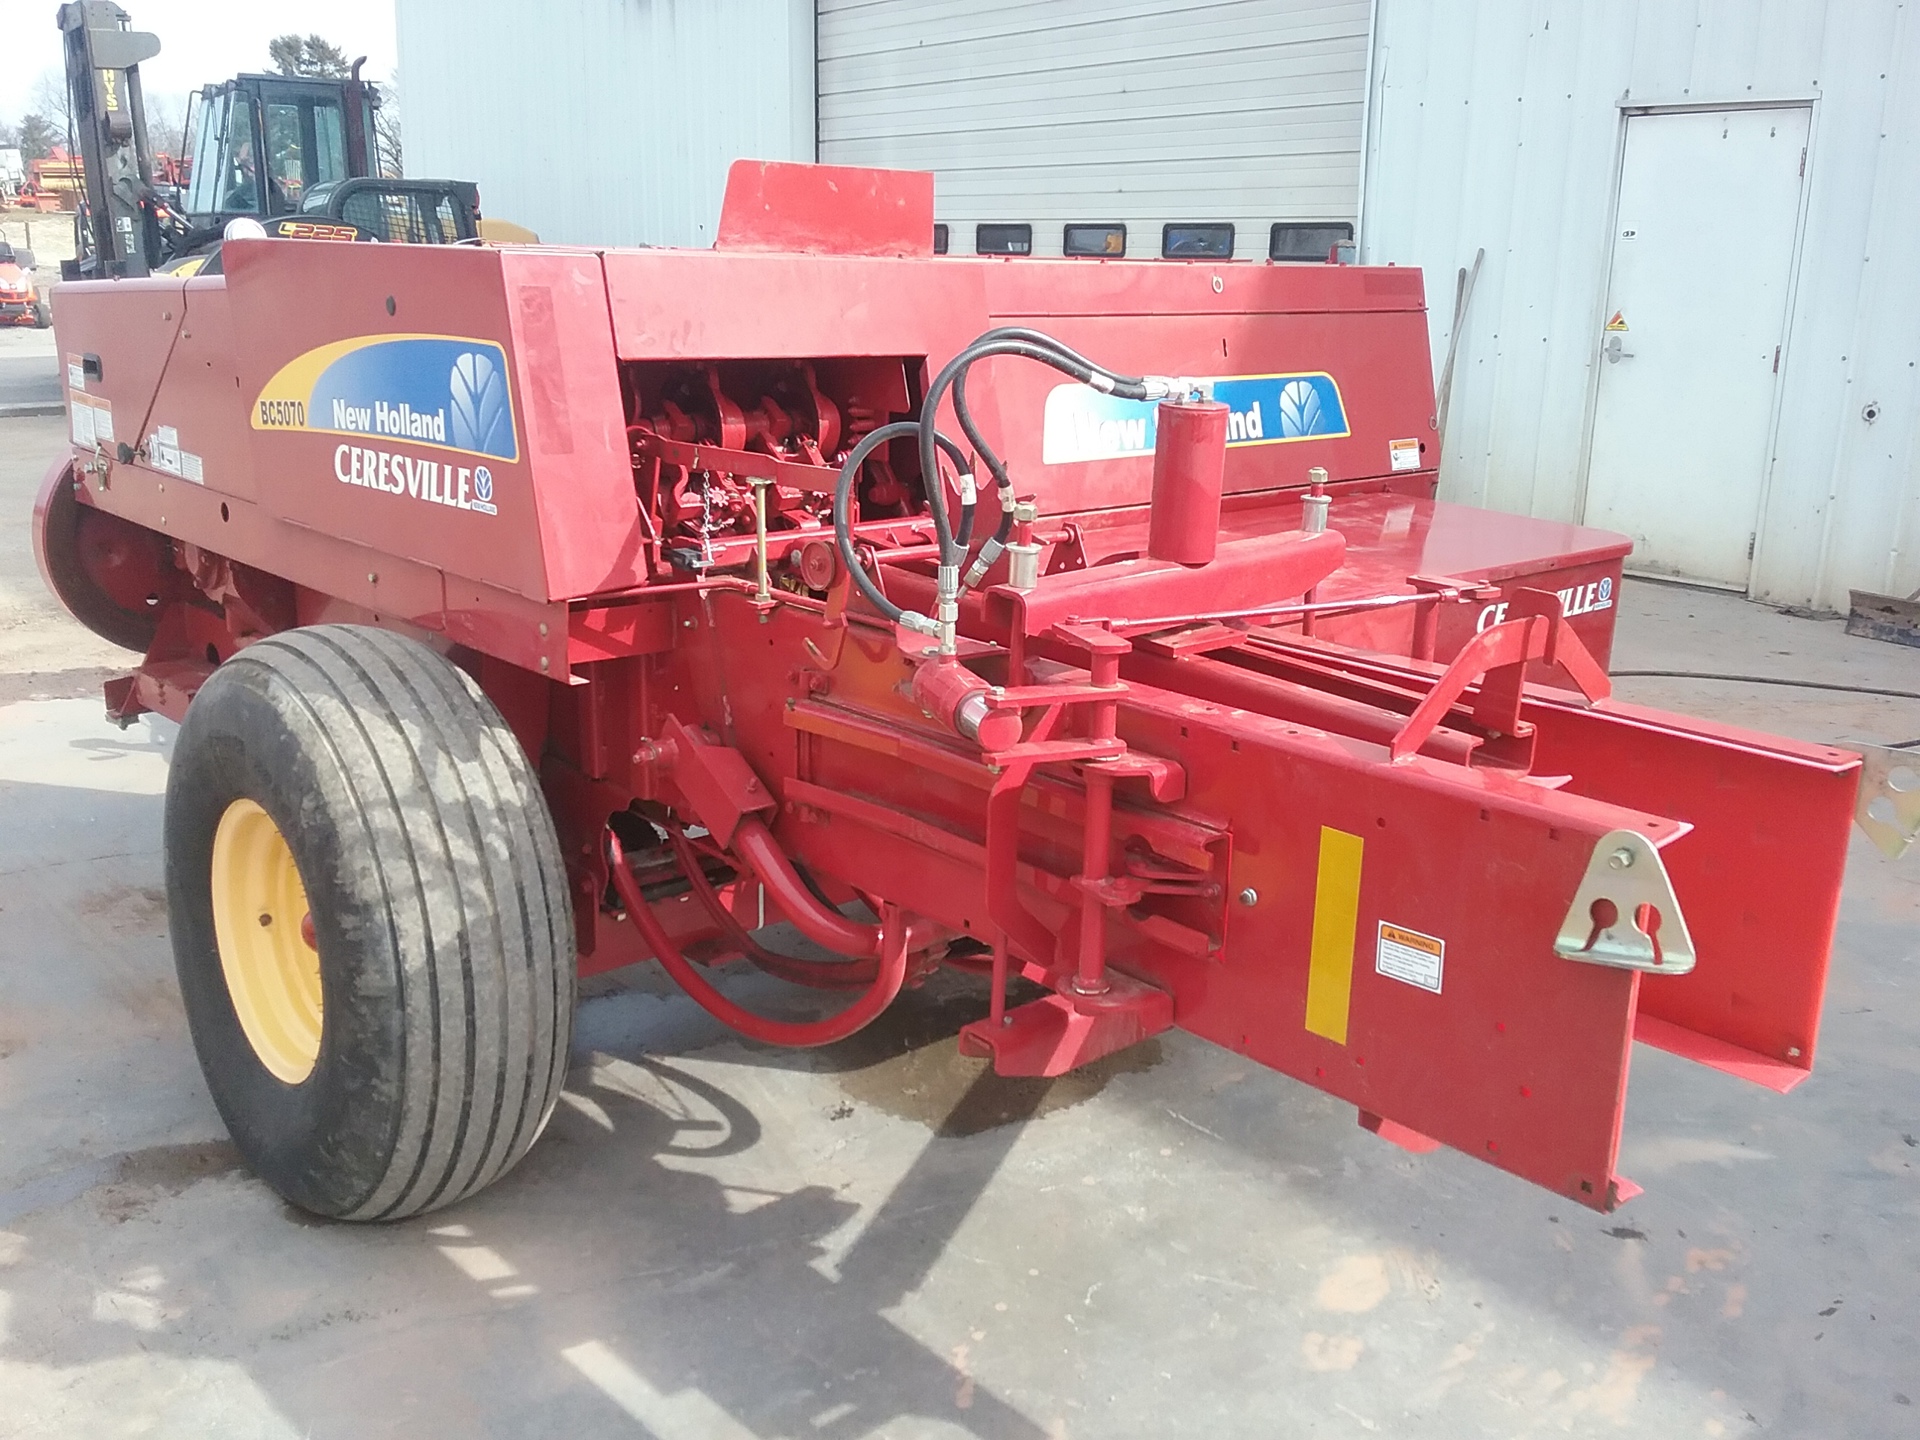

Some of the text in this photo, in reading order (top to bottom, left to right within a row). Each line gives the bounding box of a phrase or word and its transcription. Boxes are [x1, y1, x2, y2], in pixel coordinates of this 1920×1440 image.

[102, 69, 119, 111] HYS
[279, 223, 356, 241] L225
[259, 400, 304, 427] BC5070
[332, 398, 446, 442] New Holland
[334, 444, 473, 510] CERESVILLE
[1398, 933, 1435, 951] WARNING
